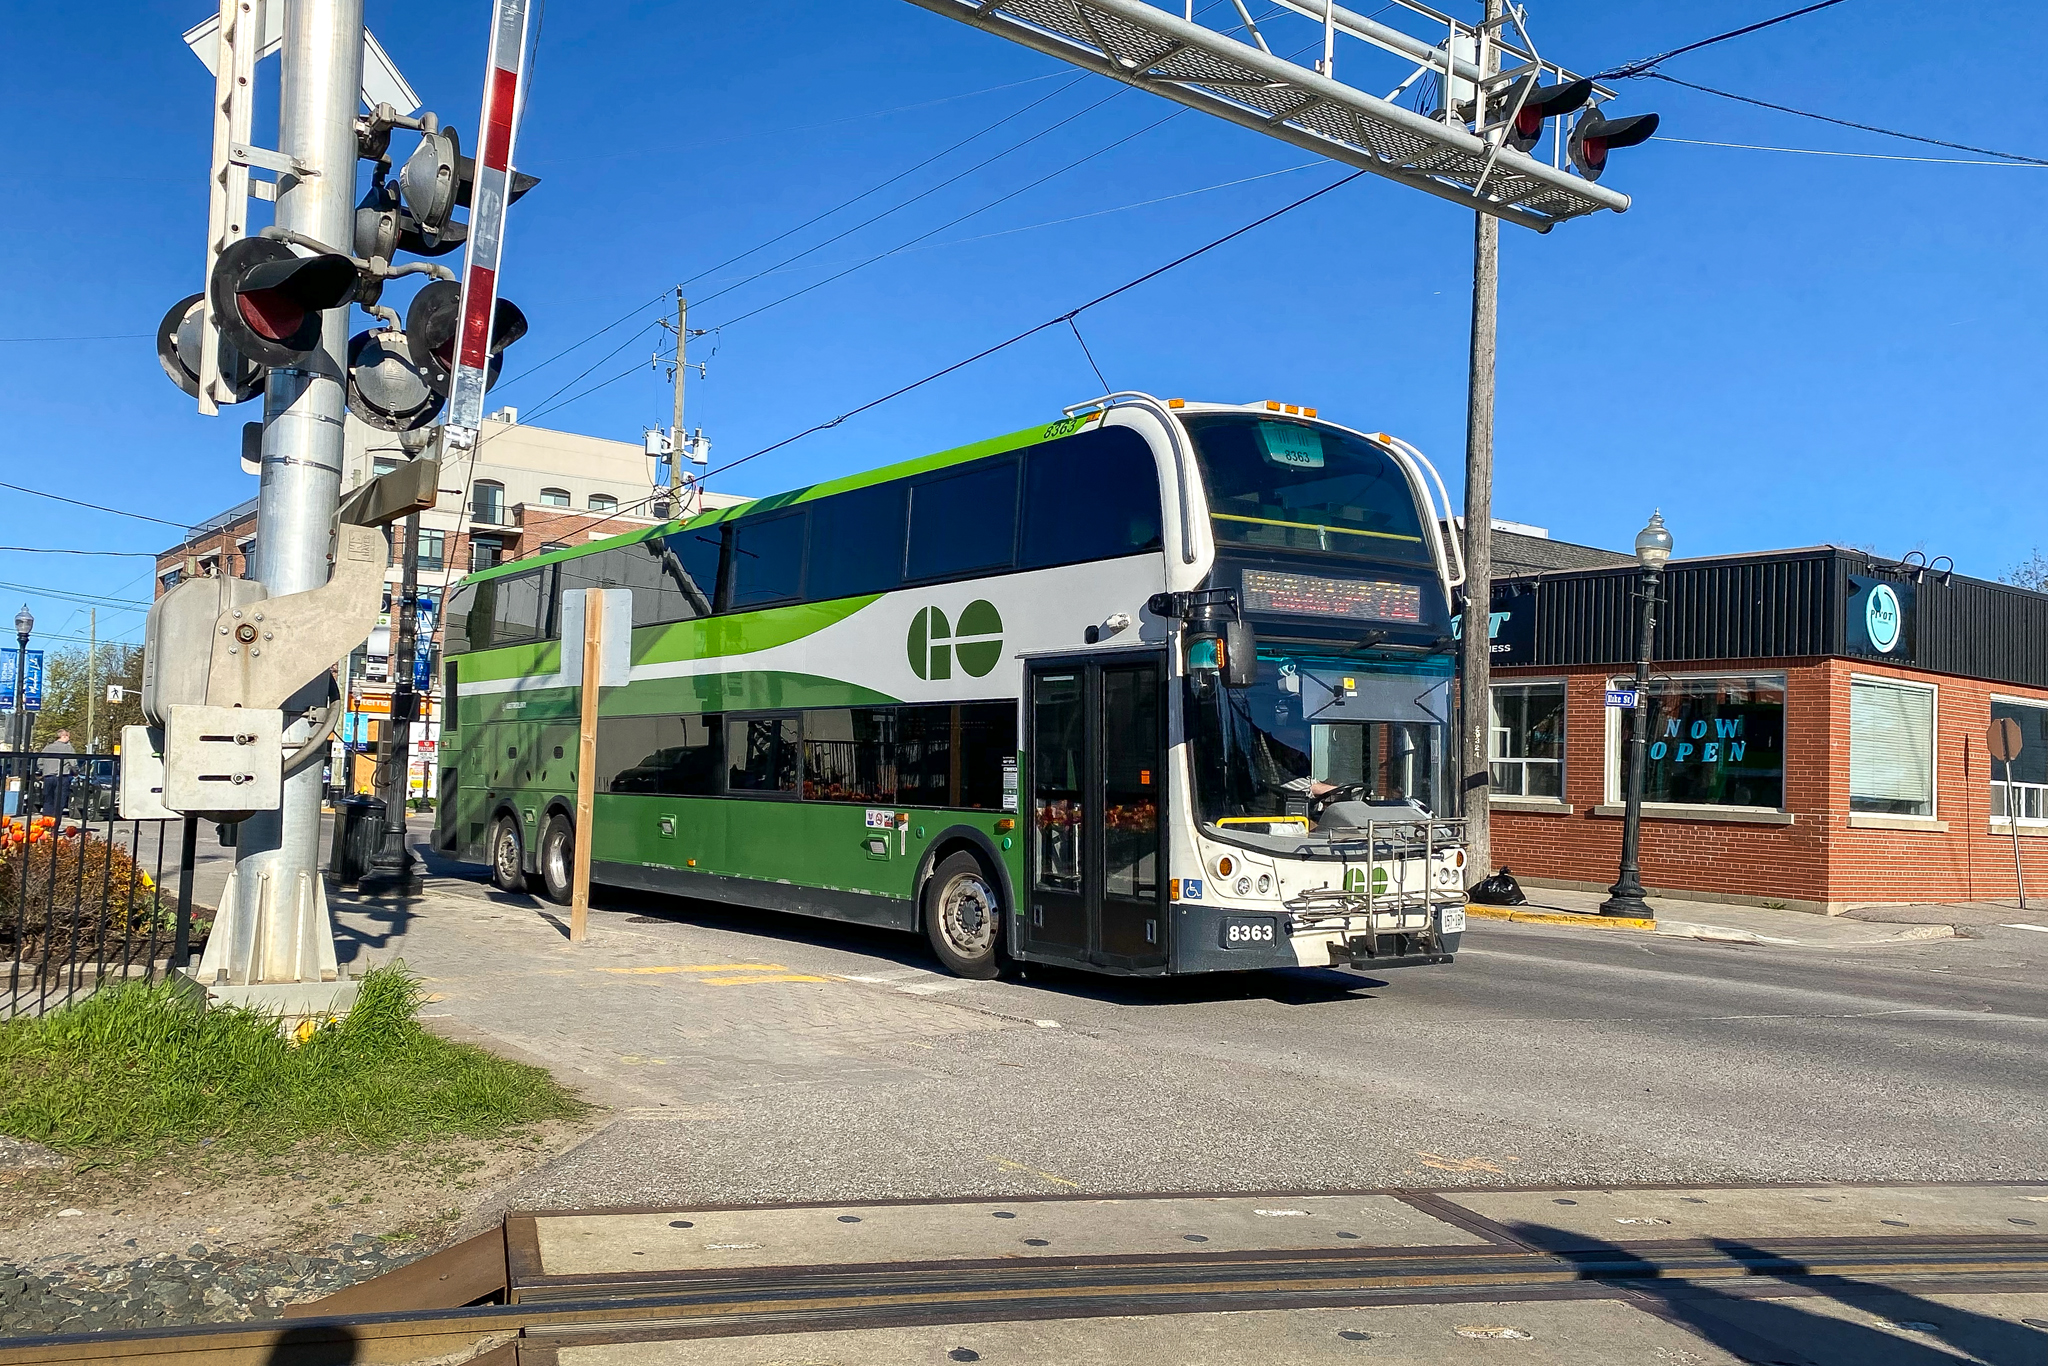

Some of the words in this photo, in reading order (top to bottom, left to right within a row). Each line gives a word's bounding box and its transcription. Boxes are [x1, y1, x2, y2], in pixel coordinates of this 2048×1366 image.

[1042, 419, 1078, 440] 8363
[1285, 448, 1311, 463] 8363
[1663, 718, 1740, 739] NOW
[1650, 740, 1747, 763] OPEN
[1228, 924, 1273, 941] 8363
